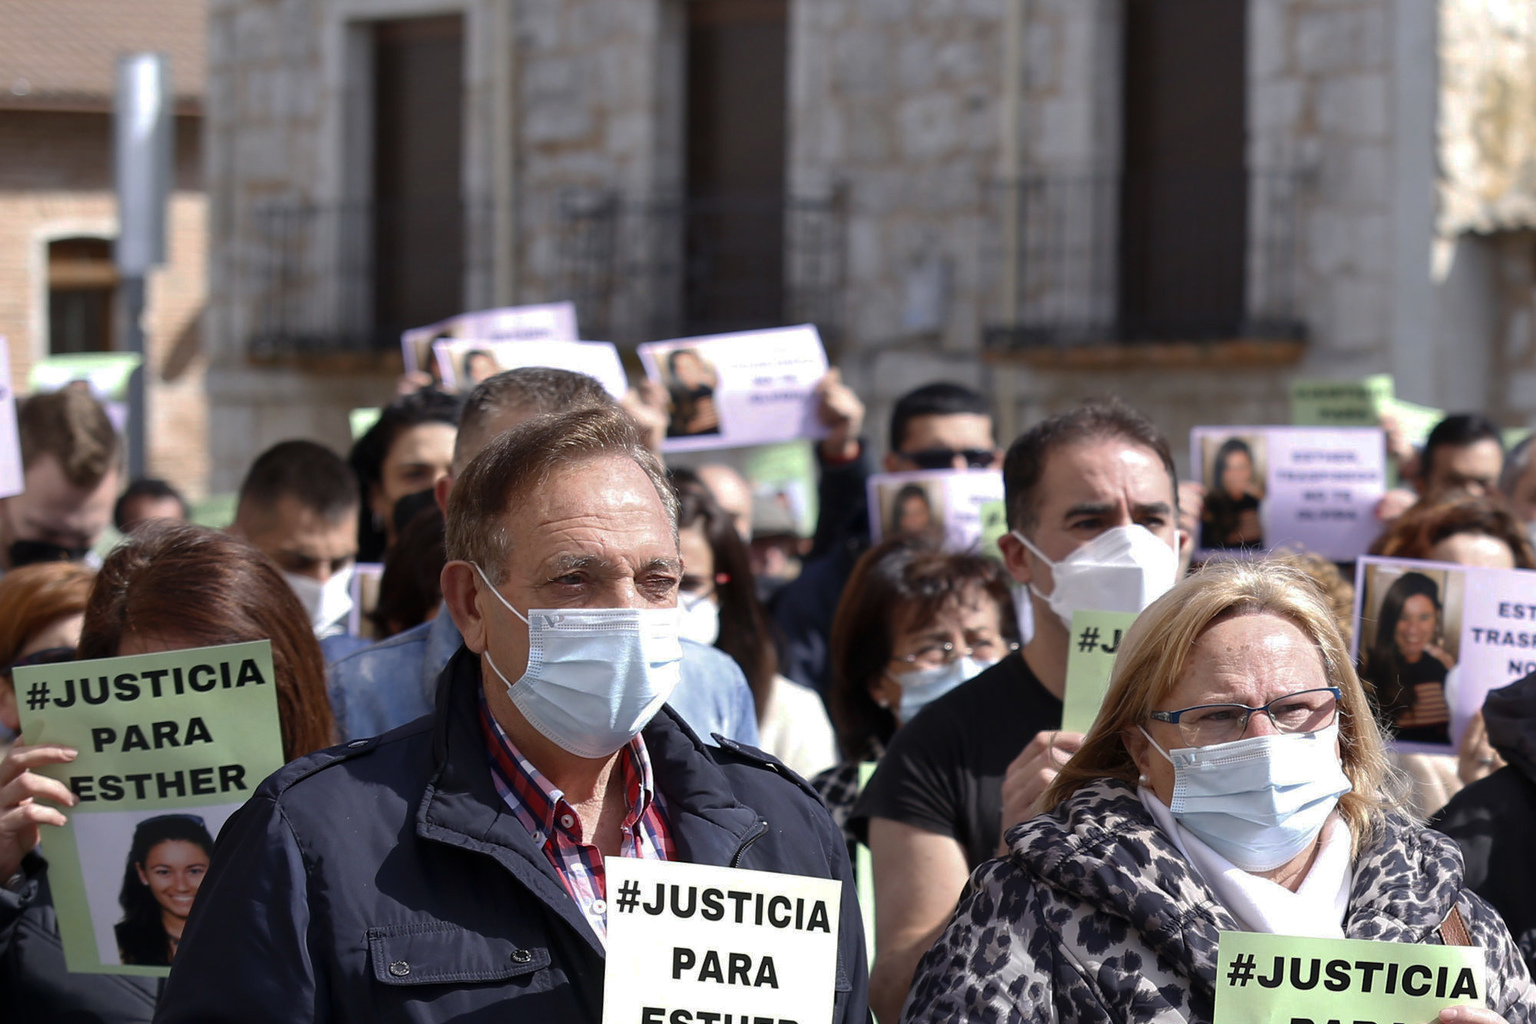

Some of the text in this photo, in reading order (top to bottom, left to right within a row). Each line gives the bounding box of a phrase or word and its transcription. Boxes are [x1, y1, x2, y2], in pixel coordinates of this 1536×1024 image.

[26, 658, 266, 711] #JUSTICIA
[91, 717, 213, 753] PARA
[70, 764, 248, 803] ESTHER
[616, 879, 831, 933] #JUSTICIA
[672, 946, 779, 989] PARA
[1226, 953, 1479, 1000] #JUSTICIA
